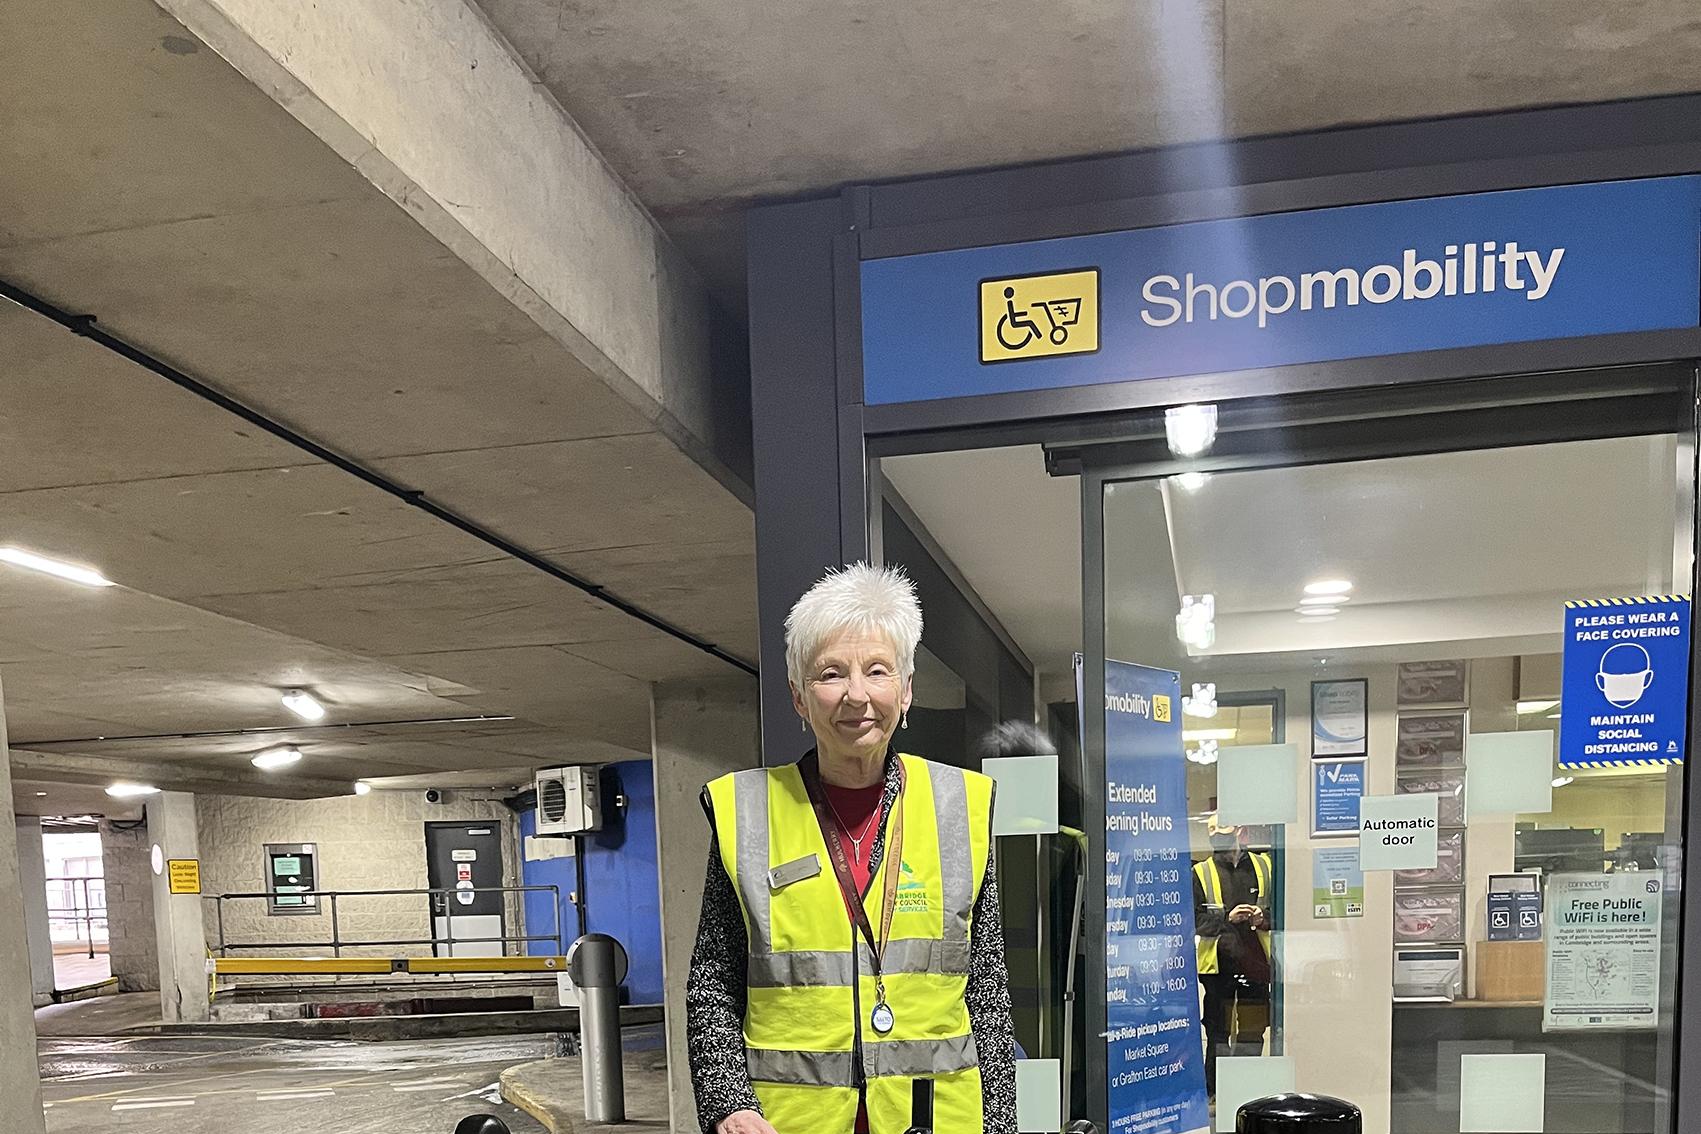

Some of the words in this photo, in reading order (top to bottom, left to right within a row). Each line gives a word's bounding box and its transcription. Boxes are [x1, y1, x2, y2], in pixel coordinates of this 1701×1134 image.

[1140, 241, 1566, 328] Shopmobility
[1575, 615, 1624, 627] PLEASE
[1628, 613, 1666, 624] WEAR
[1669, 612, 1679, 621] A
[1576, 630, 1609, 641] FACE
[1612, 627, 1680, 639] COVERING
[1591, 714, 1654, 726] MAINTAIN
[1598, 729, 1642, 740] SOCIAL
[1585, 742, 1658, 754] DISTANCING
[1109, 782, 1157, 803] Extended
[1141, 813, 1172, 831] Hours
[1363, 816, 1435, 831] Automatic
[1382, 834, 1415, 846] door
[1135, 871, 1153, 884] 09:30
[1160, 870, 1179, 882] 18:30
[1136, 893, 1154, 906] 09:30
[1161, 892, 1180, 904] 19:00
[1572, 900, 1599, 910] Free
[1603, 898, 1642, 909] Public
[1137, 915, 1156, 929] 09:30
[1163, 913, 1182, 926] 18:30
[1564, 912, 1593, 923] WiFi
[1597, 912, 1607, 922] is
[1165, 956, 1185, 970] 19:00
[1167, 978, 1187, 992] 16:00
[1125, 1047, 1147, 1062] Market
[1147, 1042, 1169, 1058] Square
[1112, 1076, 1119, 1088] or
[1119, 1070, 1143, 1086] Grafton
[1144, 1068, 1158, 1080] East
[1158, 1066, 1168, 1076] car
